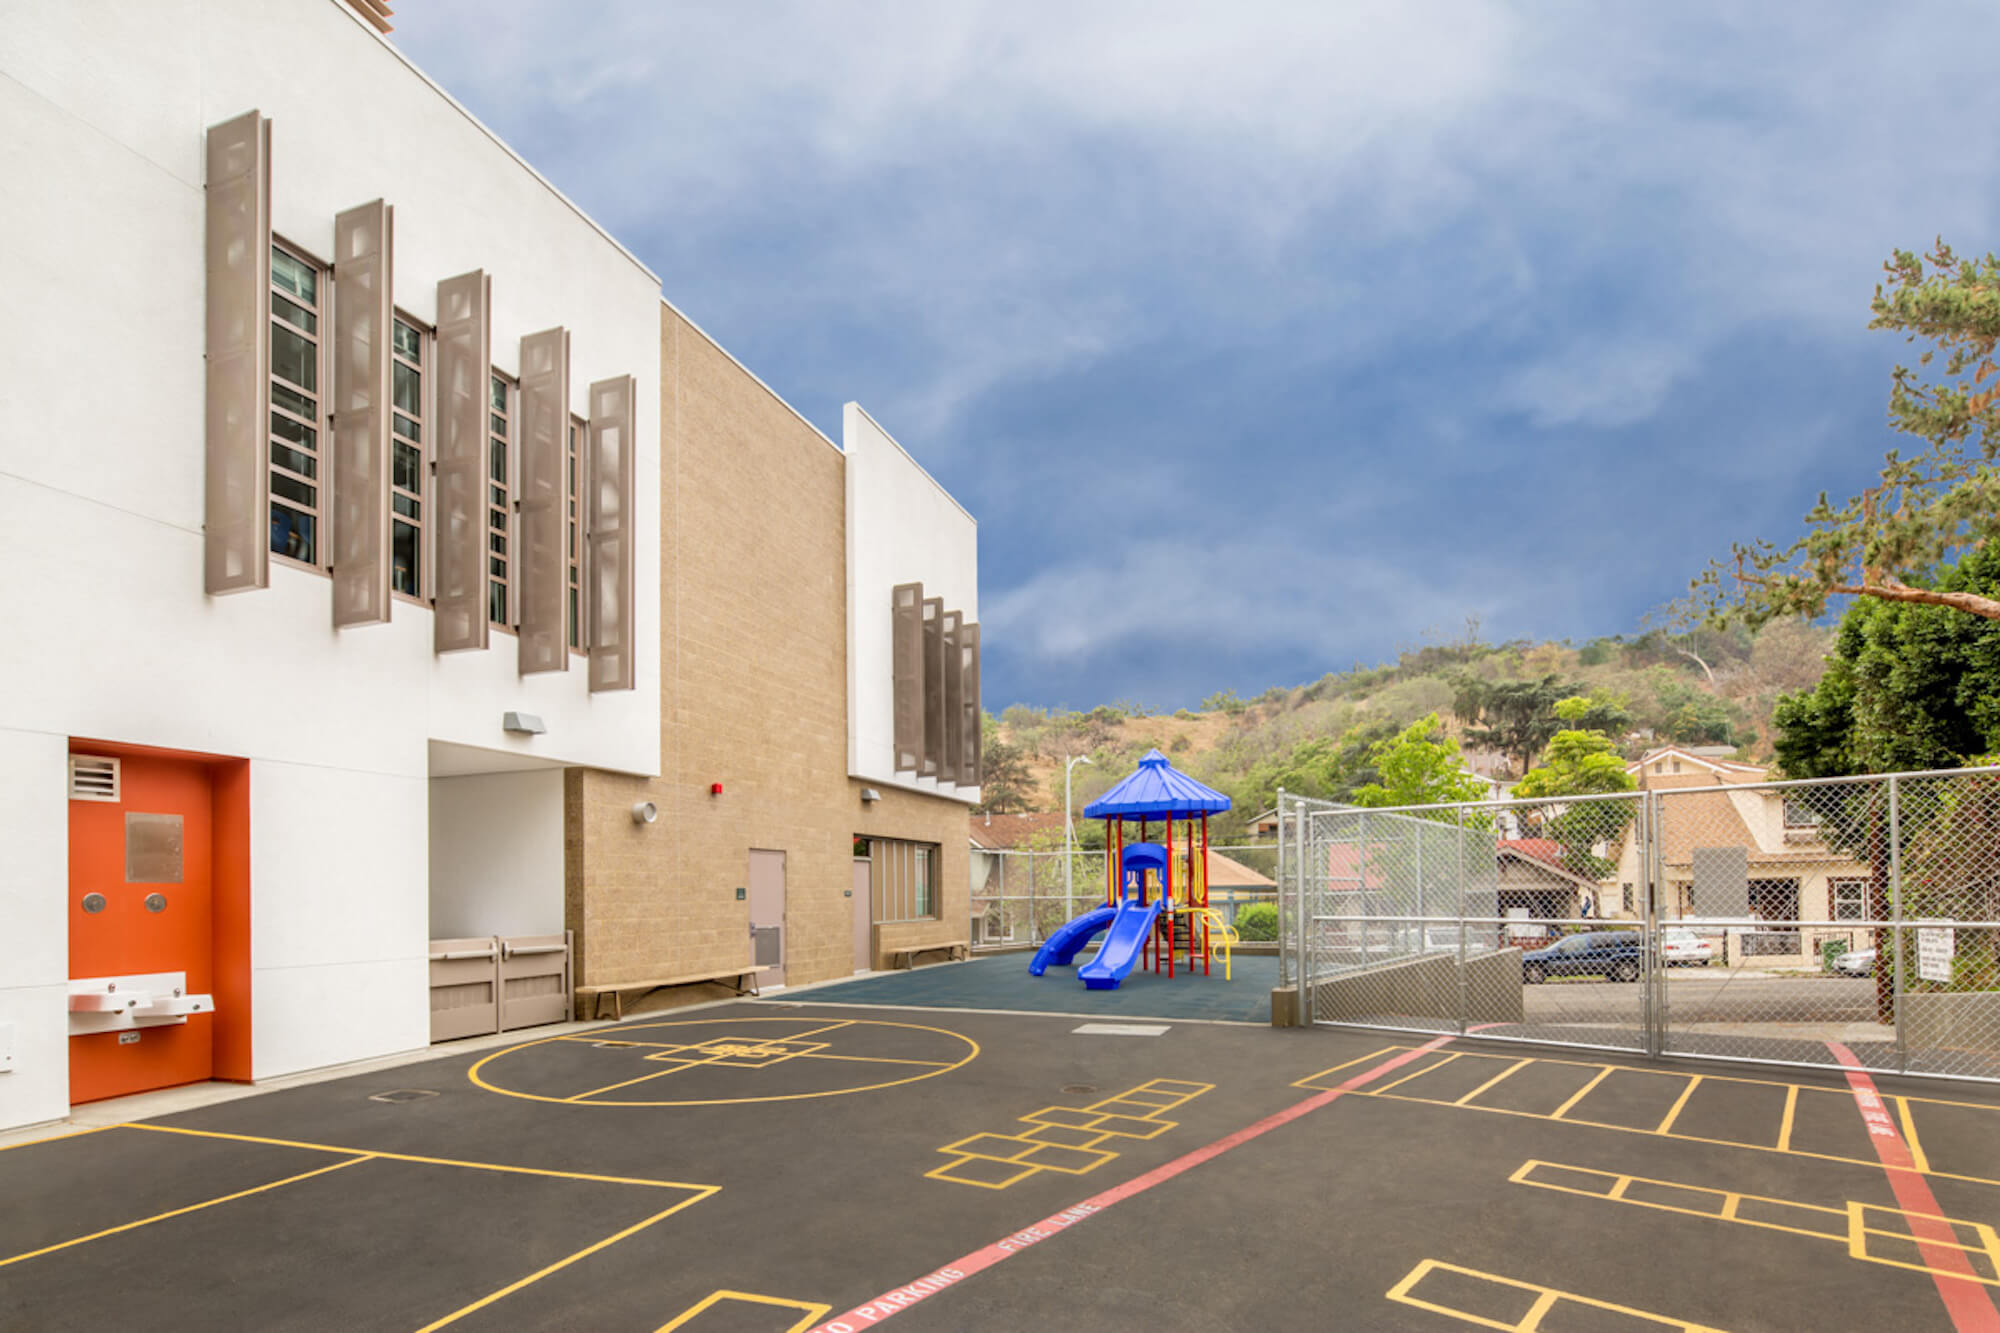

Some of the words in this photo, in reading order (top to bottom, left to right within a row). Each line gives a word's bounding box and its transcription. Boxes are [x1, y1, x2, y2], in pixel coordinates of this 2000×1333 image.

[814, 1322, 853, 1333] O
[856, 1268, 964, 1320] PARKING
[998, 1228, 1052, 1252] FIRE
[1047, 1203, 1101, 1226] LANE
